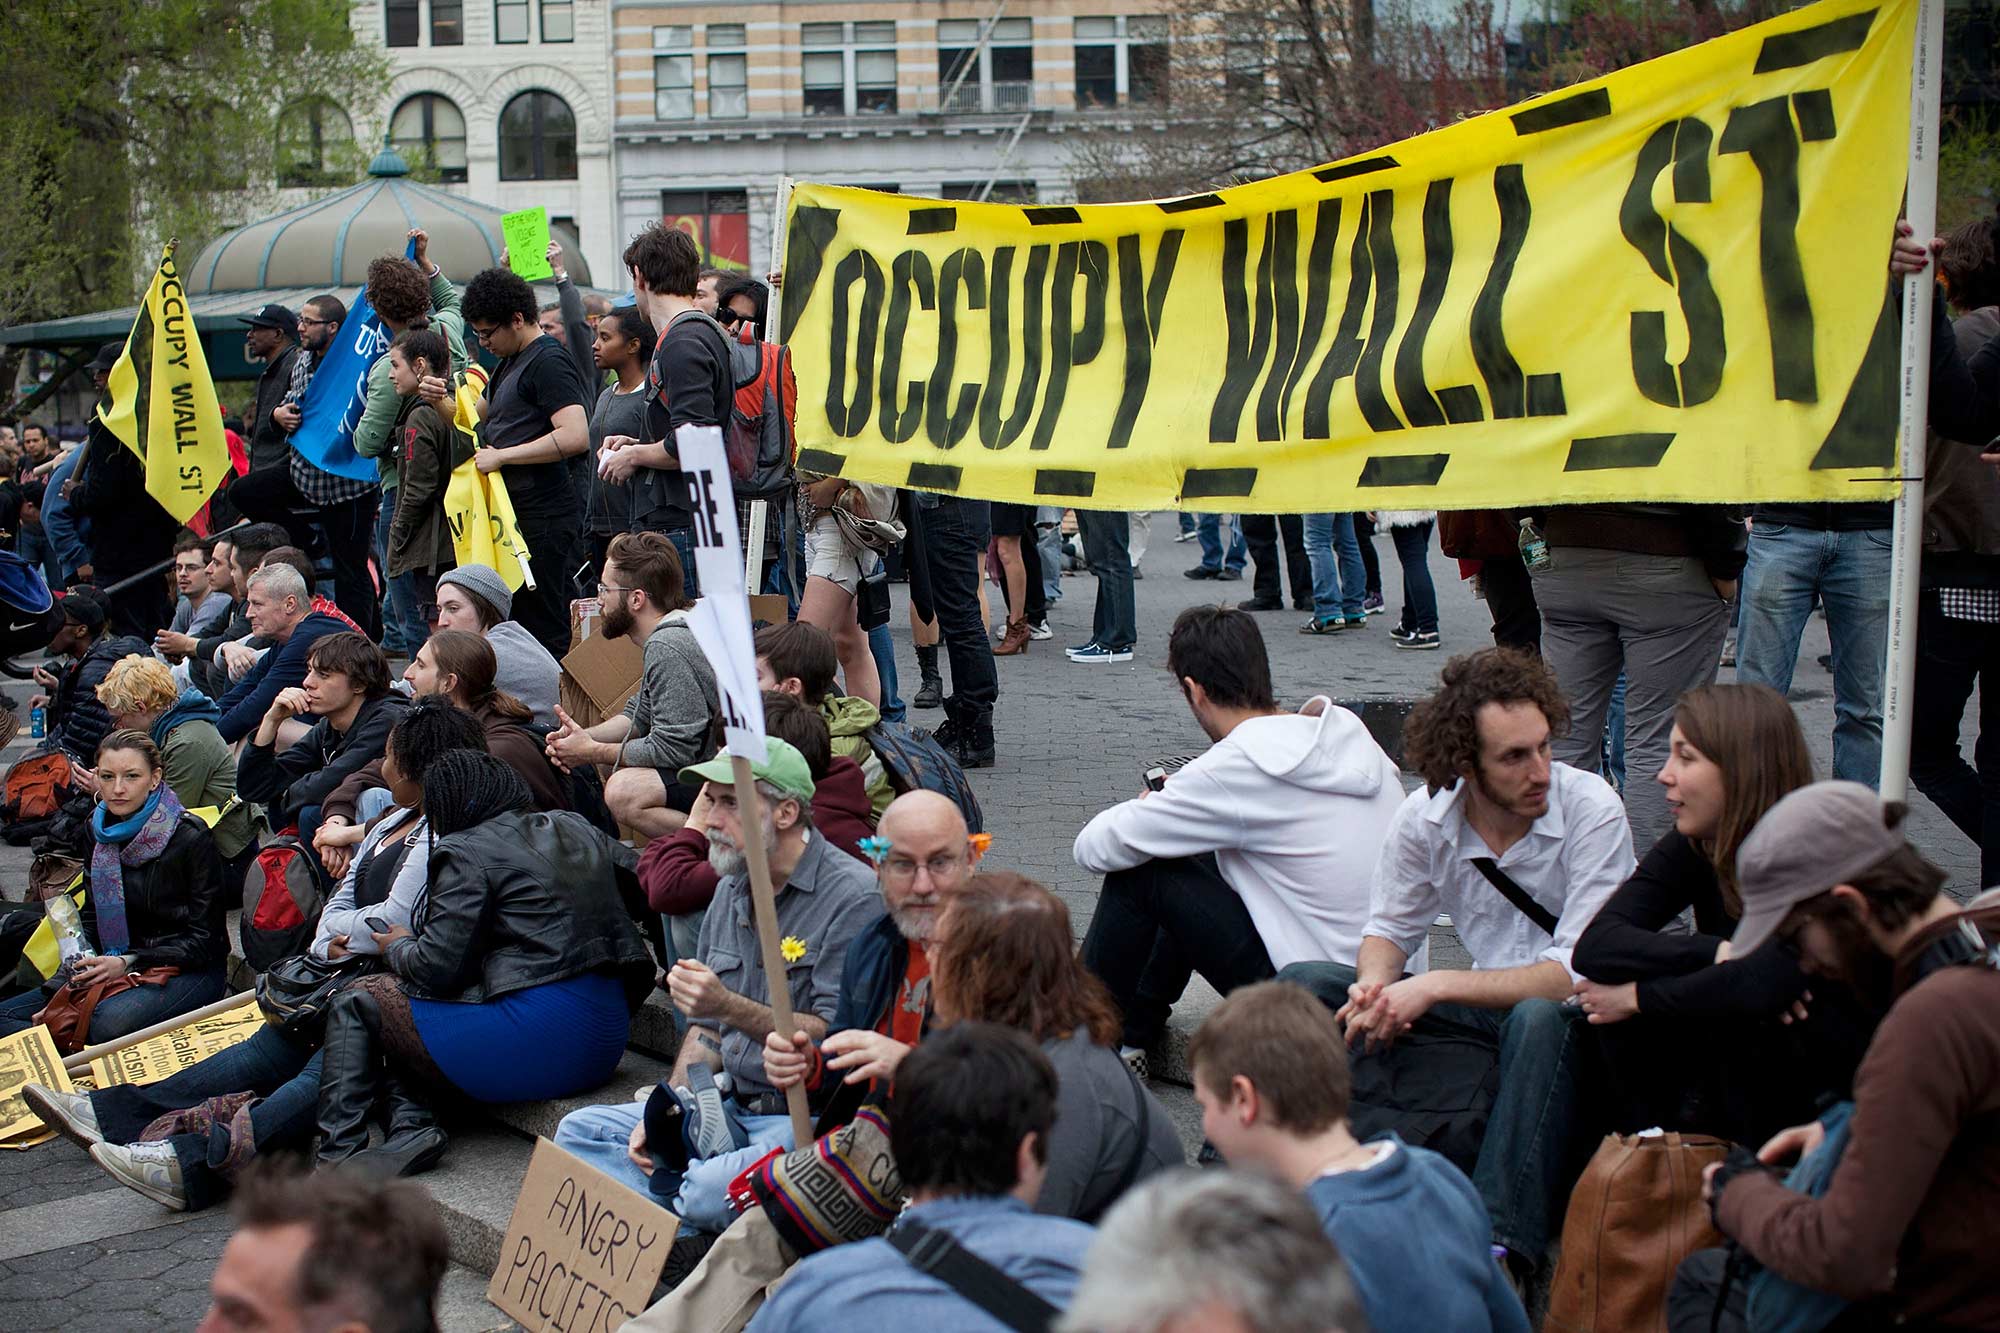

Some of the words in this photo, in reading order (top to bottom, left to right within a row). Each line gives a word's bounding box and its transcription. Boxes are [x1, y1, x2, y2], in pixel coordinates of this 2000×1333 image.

[160, 257, 190, 370] OCCUPY
[511, 248, 541, 275] OWS
[825, 229, 1185, 450] OCCUPY
[1208, 164, 1567, 443] WALL
[1620, 88, 1836, 408] ST
[170, 383, 198, 454] WALL
[547, 1176, 657, 1283] ANGRY
